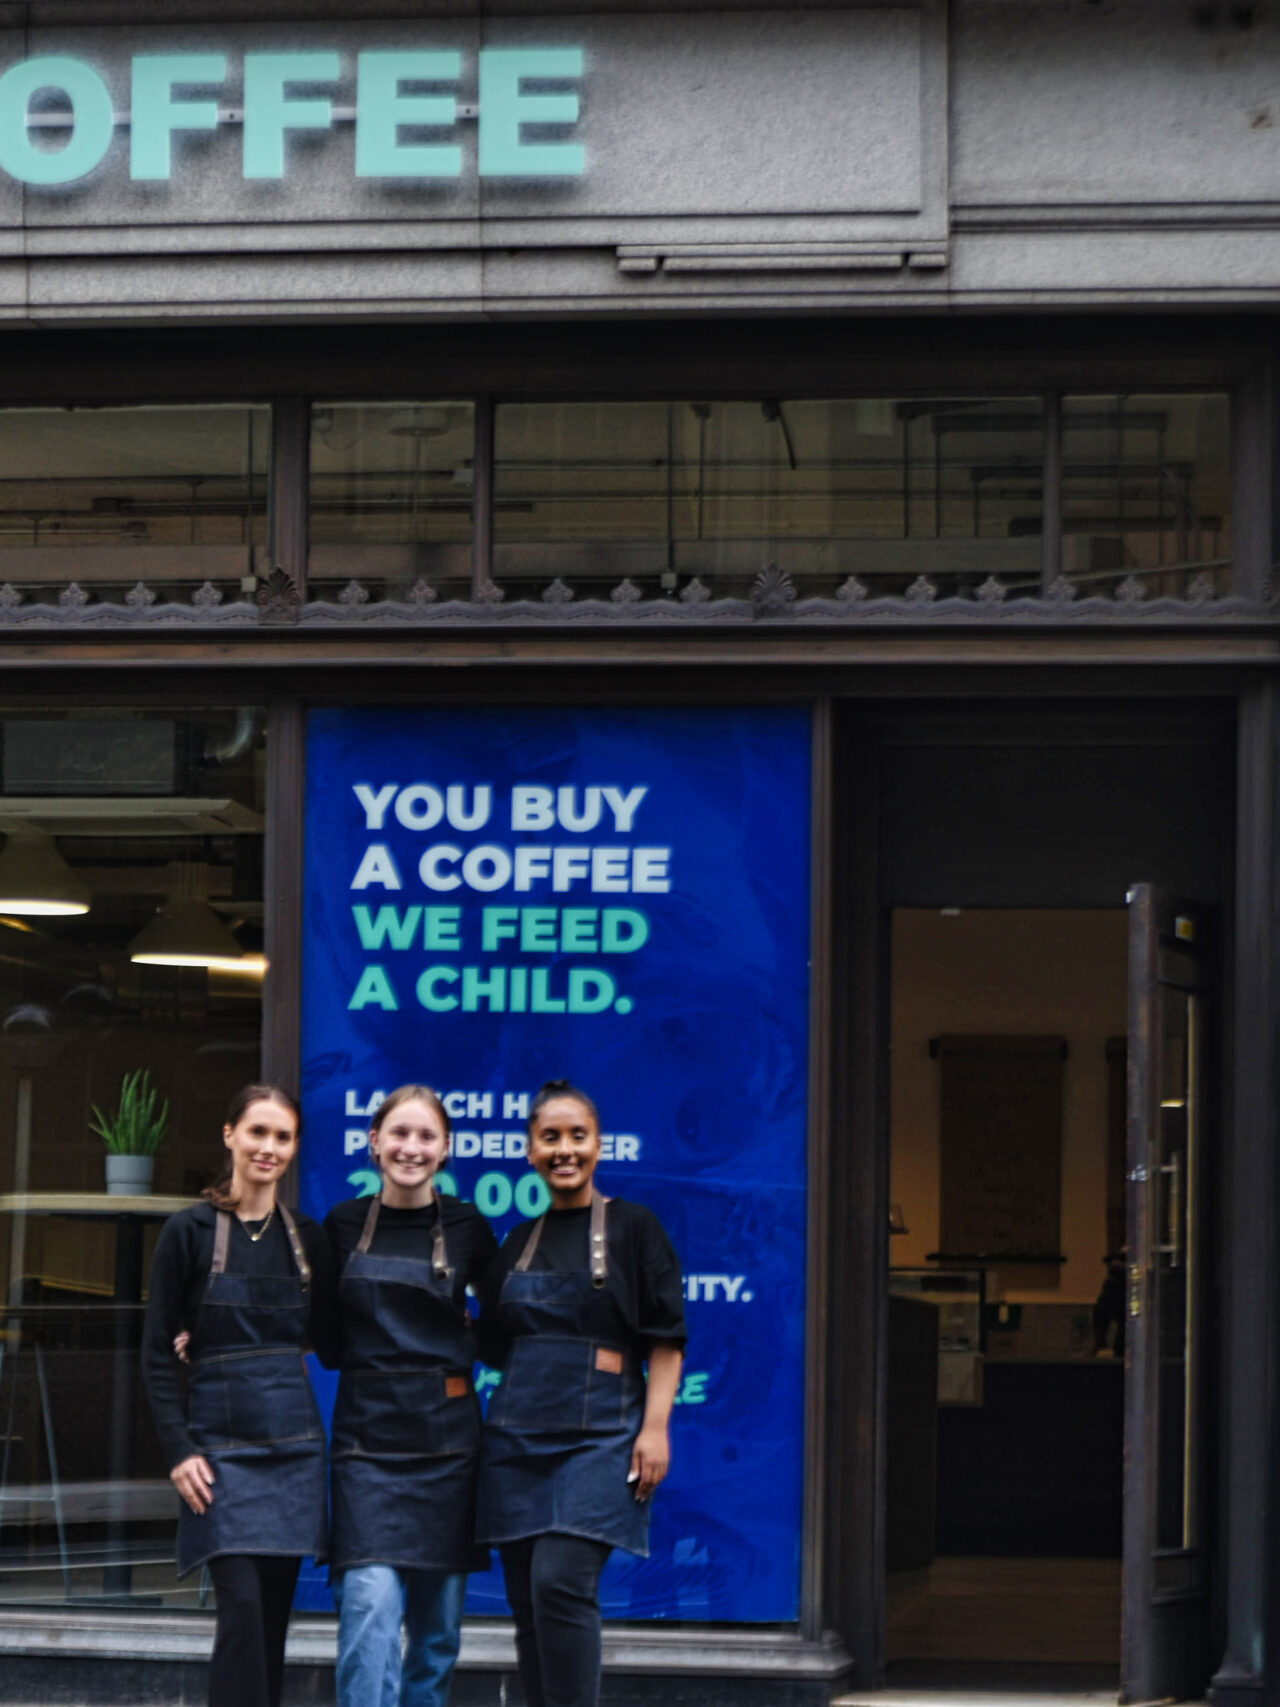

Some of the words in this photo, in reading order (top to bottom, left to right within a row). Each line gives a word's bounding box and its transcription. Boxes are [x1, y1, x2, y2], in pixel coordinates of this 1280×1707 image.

[351, 783, 492, 832] YOU
[510, 784, 649, 833] BUY
[350, 843, 402, 891] A
[418, 844, 672, 894] COFFEE
[351, 904, 462, 951] WE
[481, 905, 650, 954] FEED
[347, 964, 399, 1011] A
[415, 964, 633, 1015] CHILD.
